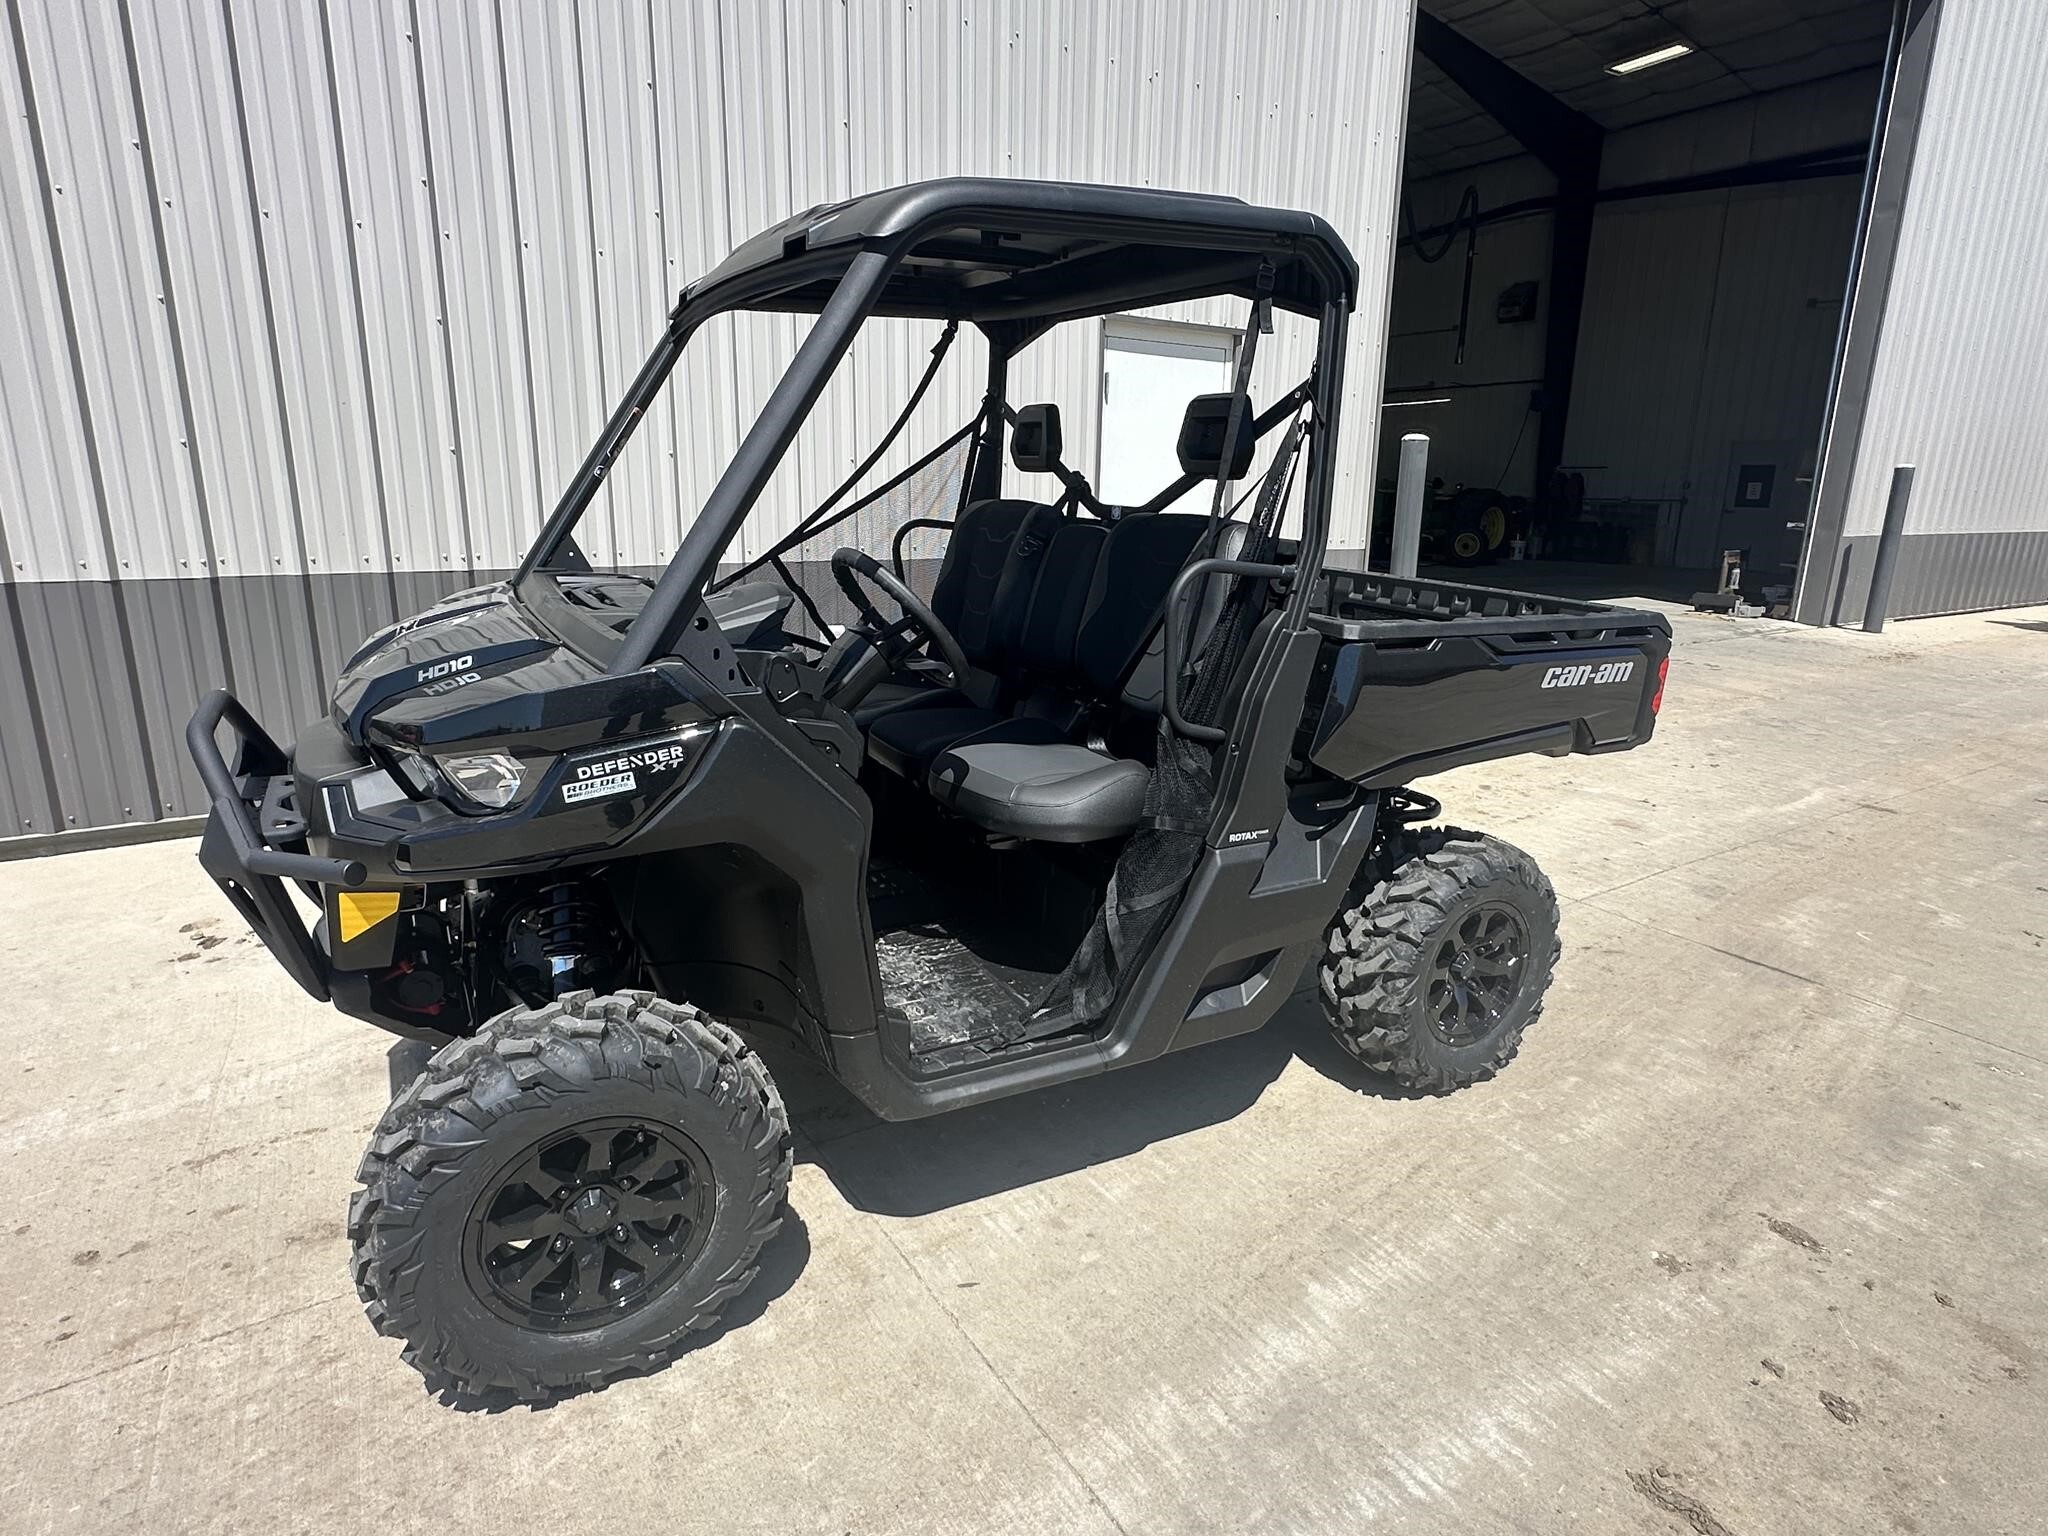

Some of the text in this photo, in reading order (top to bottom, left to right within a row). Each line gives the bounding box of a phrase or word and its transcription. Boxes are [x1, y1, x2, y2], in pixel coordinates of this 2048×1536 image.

[417, 655, 473, 683] HD10
[1541, 661, 1634, 689] can-am
[577, 746, 684, 780] DEFENDER
[650, 757, 684, 774] XT
[566, 774, 632, 794] ROEDER
[1229, 831, 1258, 843] ROTAX
